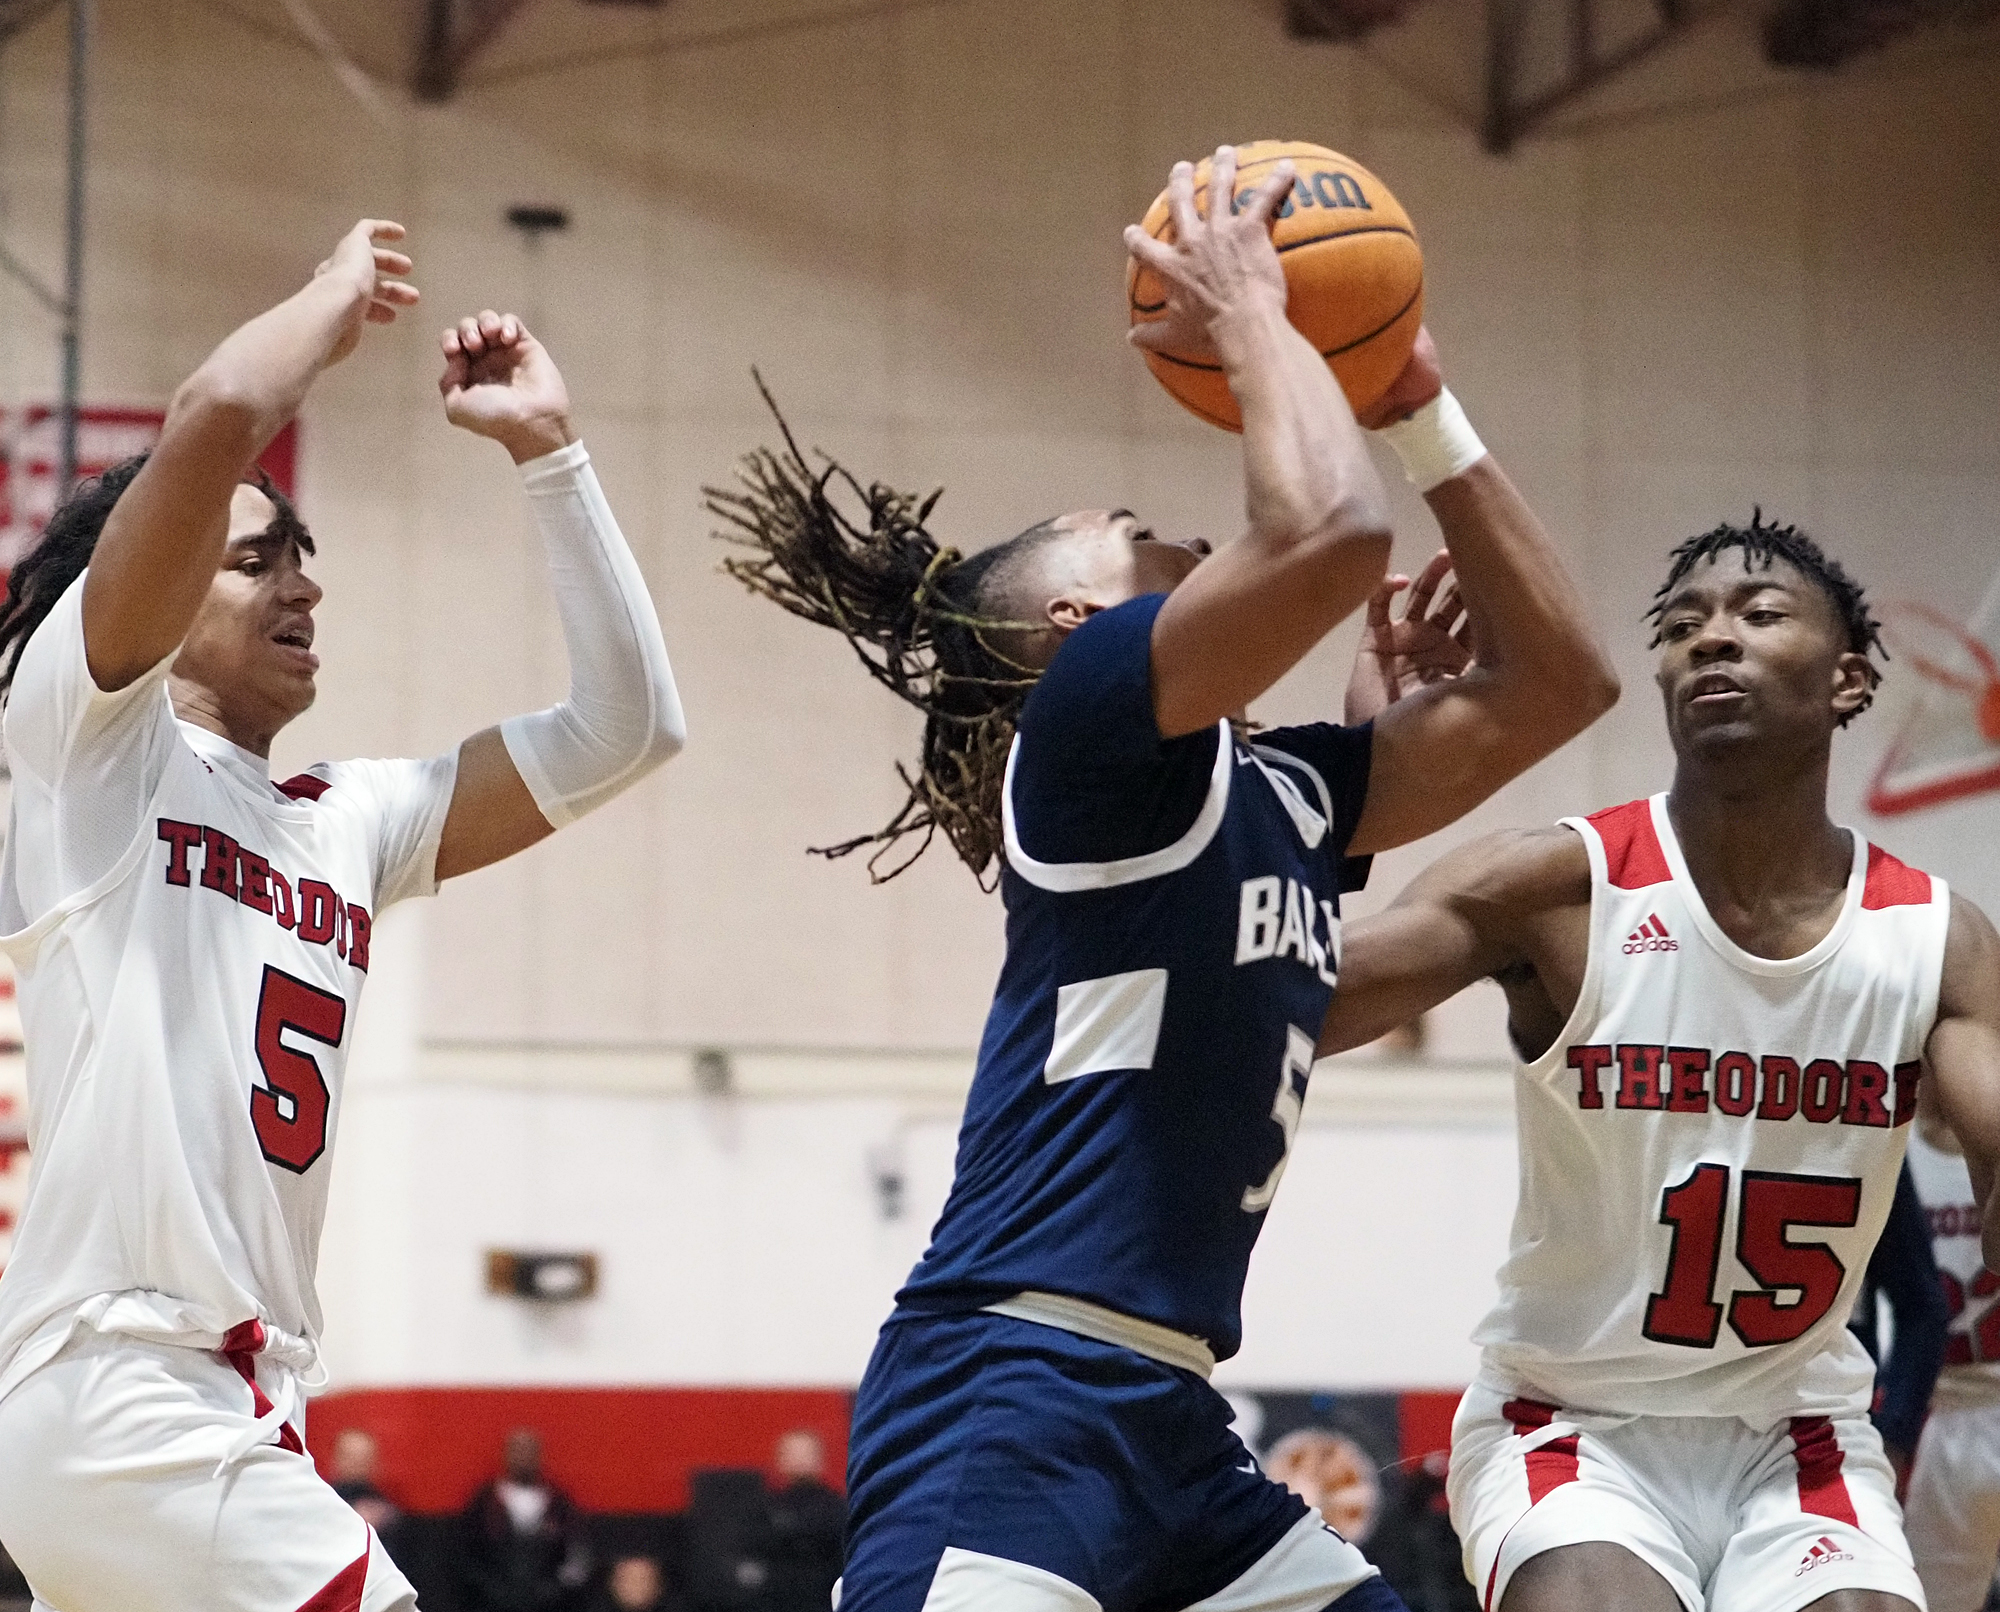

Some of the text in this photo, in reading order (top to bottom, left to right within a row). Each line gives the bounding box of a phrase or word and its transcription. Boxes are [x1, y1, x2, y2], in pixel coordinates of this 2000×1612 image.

[1622, 936, 1679, 955] adidas
[250, 962, 346, 1175] 5
[1642, 1162, 1862, 1349] 15
